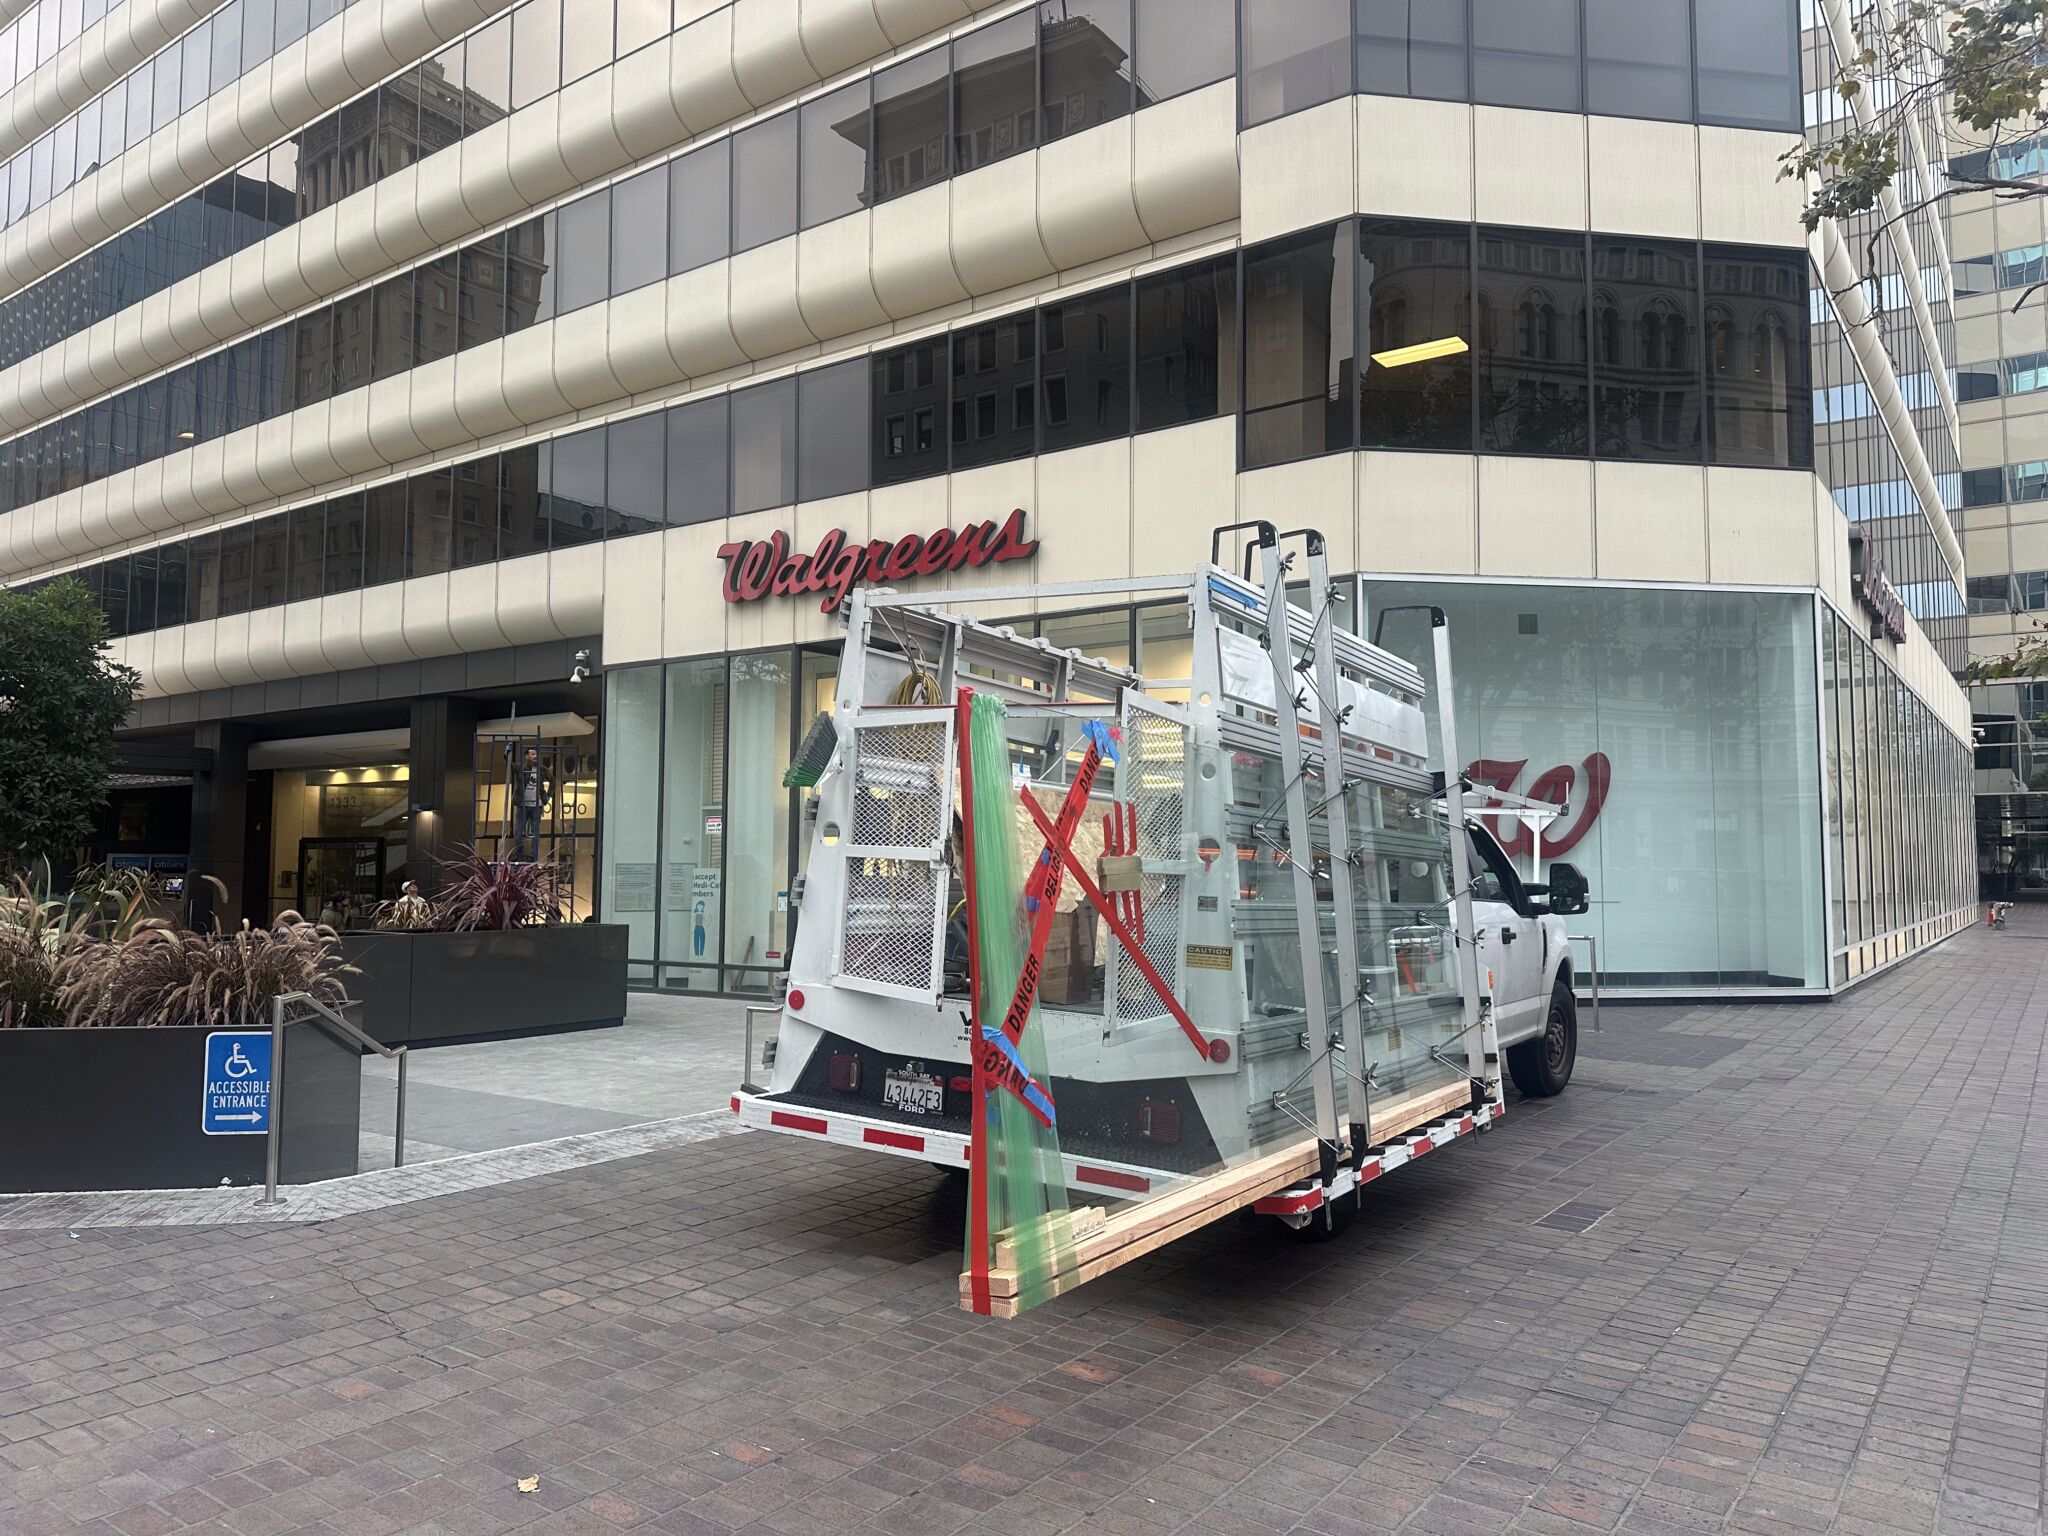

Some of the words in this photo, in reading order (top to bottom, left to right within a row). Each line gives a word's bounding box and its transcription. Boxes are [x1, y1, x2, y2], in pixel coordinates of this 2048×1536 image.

[717, 508, 1040, 614] Walgreens
[1188, 946, 1230, 955] CAUTION
[1008, 953, 1040, 1034] DANGER
[898, 1070, 918, 1078] SOUTH
[208, 1081, 271, 1094] ACCESSIBLE
[213, 1095, 267, 1108] ENTRANCE
[886, 1083, 941, 1110] 43442F3
[898, 1104, 925, 1114] FORD
